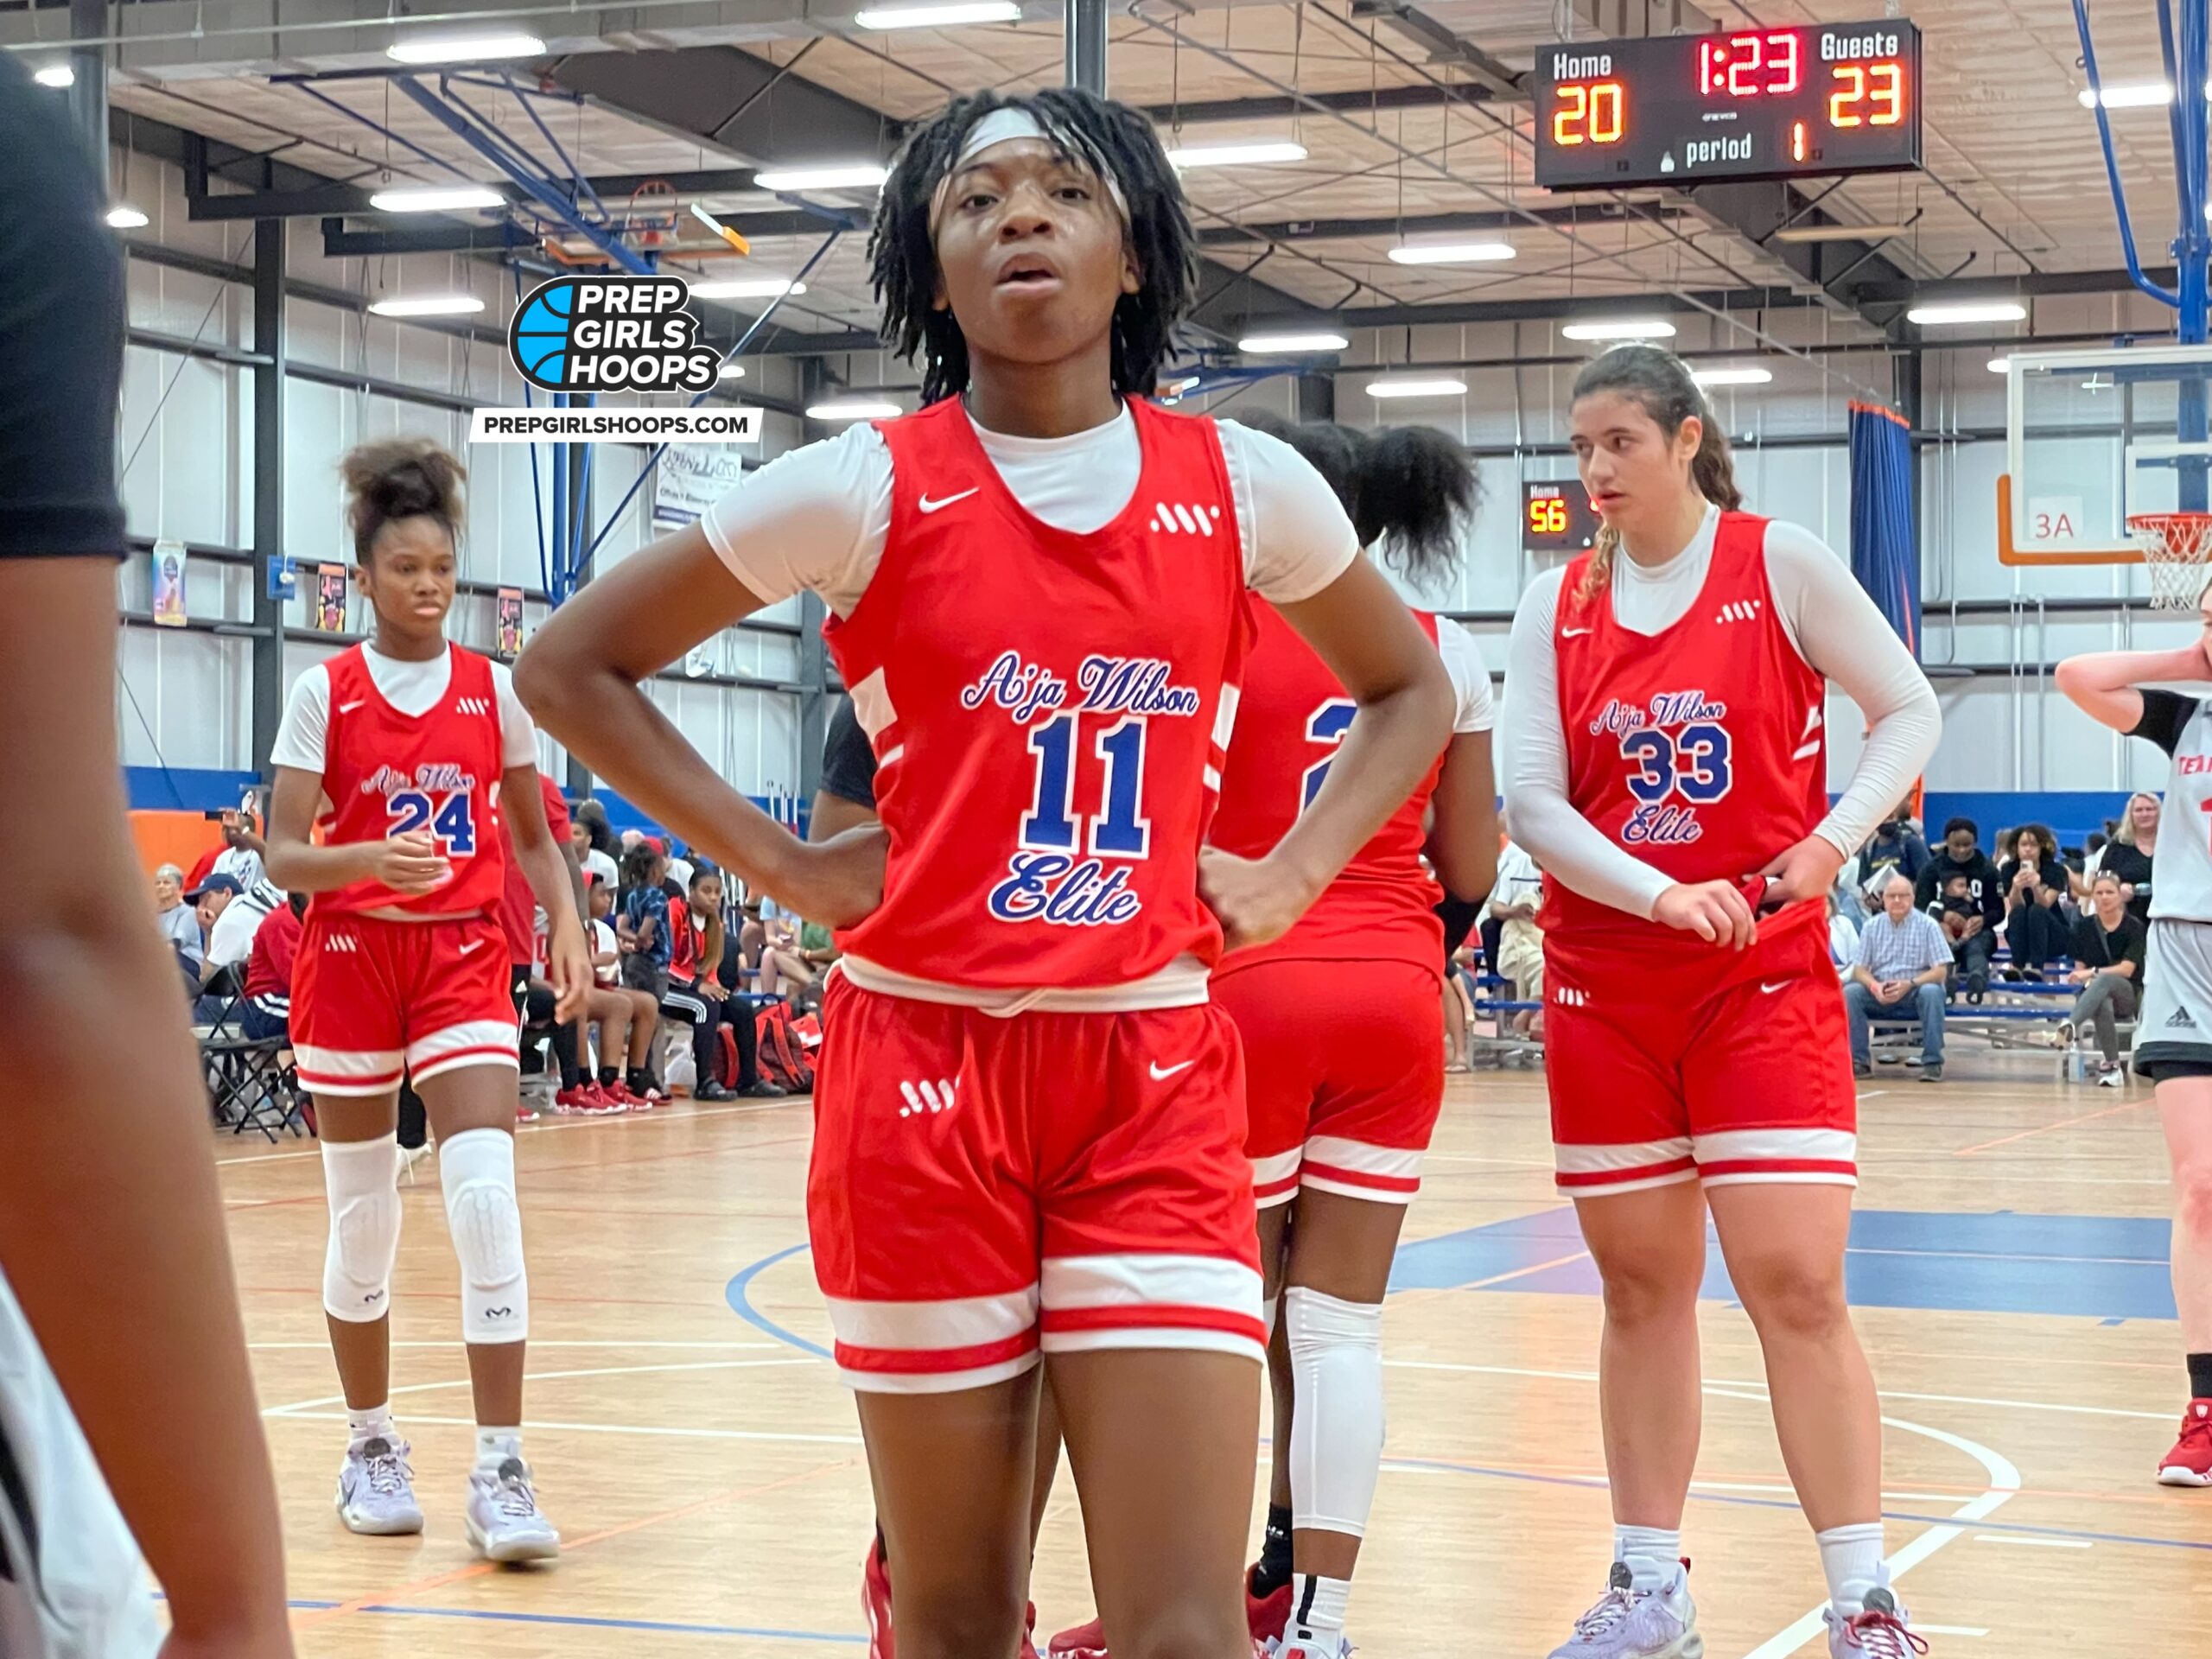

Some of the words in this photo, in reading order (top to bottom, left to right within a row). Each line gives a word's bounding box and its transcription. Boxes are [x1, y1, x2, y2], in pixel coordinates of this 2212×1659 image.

[1700, 33, 1797, 96] 1:23
[1821, 31, 1898, 60] Guests
[1554, 53, 1612, 80] Home
[1554, 83, 1623, 145] 20
[1829, 63, 1901, 128] 23
[1687, 132, 1752, 168] period
[1793, 122, 1804, 162] 1
[1529, 499, 1567, 532] 56
[2036, 513, 2074, 538] 3A
[961, 650, 1066, 724] A'ja
[1078, 654, 1200, 717] Wilson
[1650, 690, 1727, 728] Wilson
[1618, 721, 1733, 804] 33
[2178, 754, 2212, 776] TEA
[1018, 709, 1152, 860] 11
[386, 787, 476, 857] 24
[1621, 803, 1703, 844] Elite
[987, 850, 1142, 926] Elite
